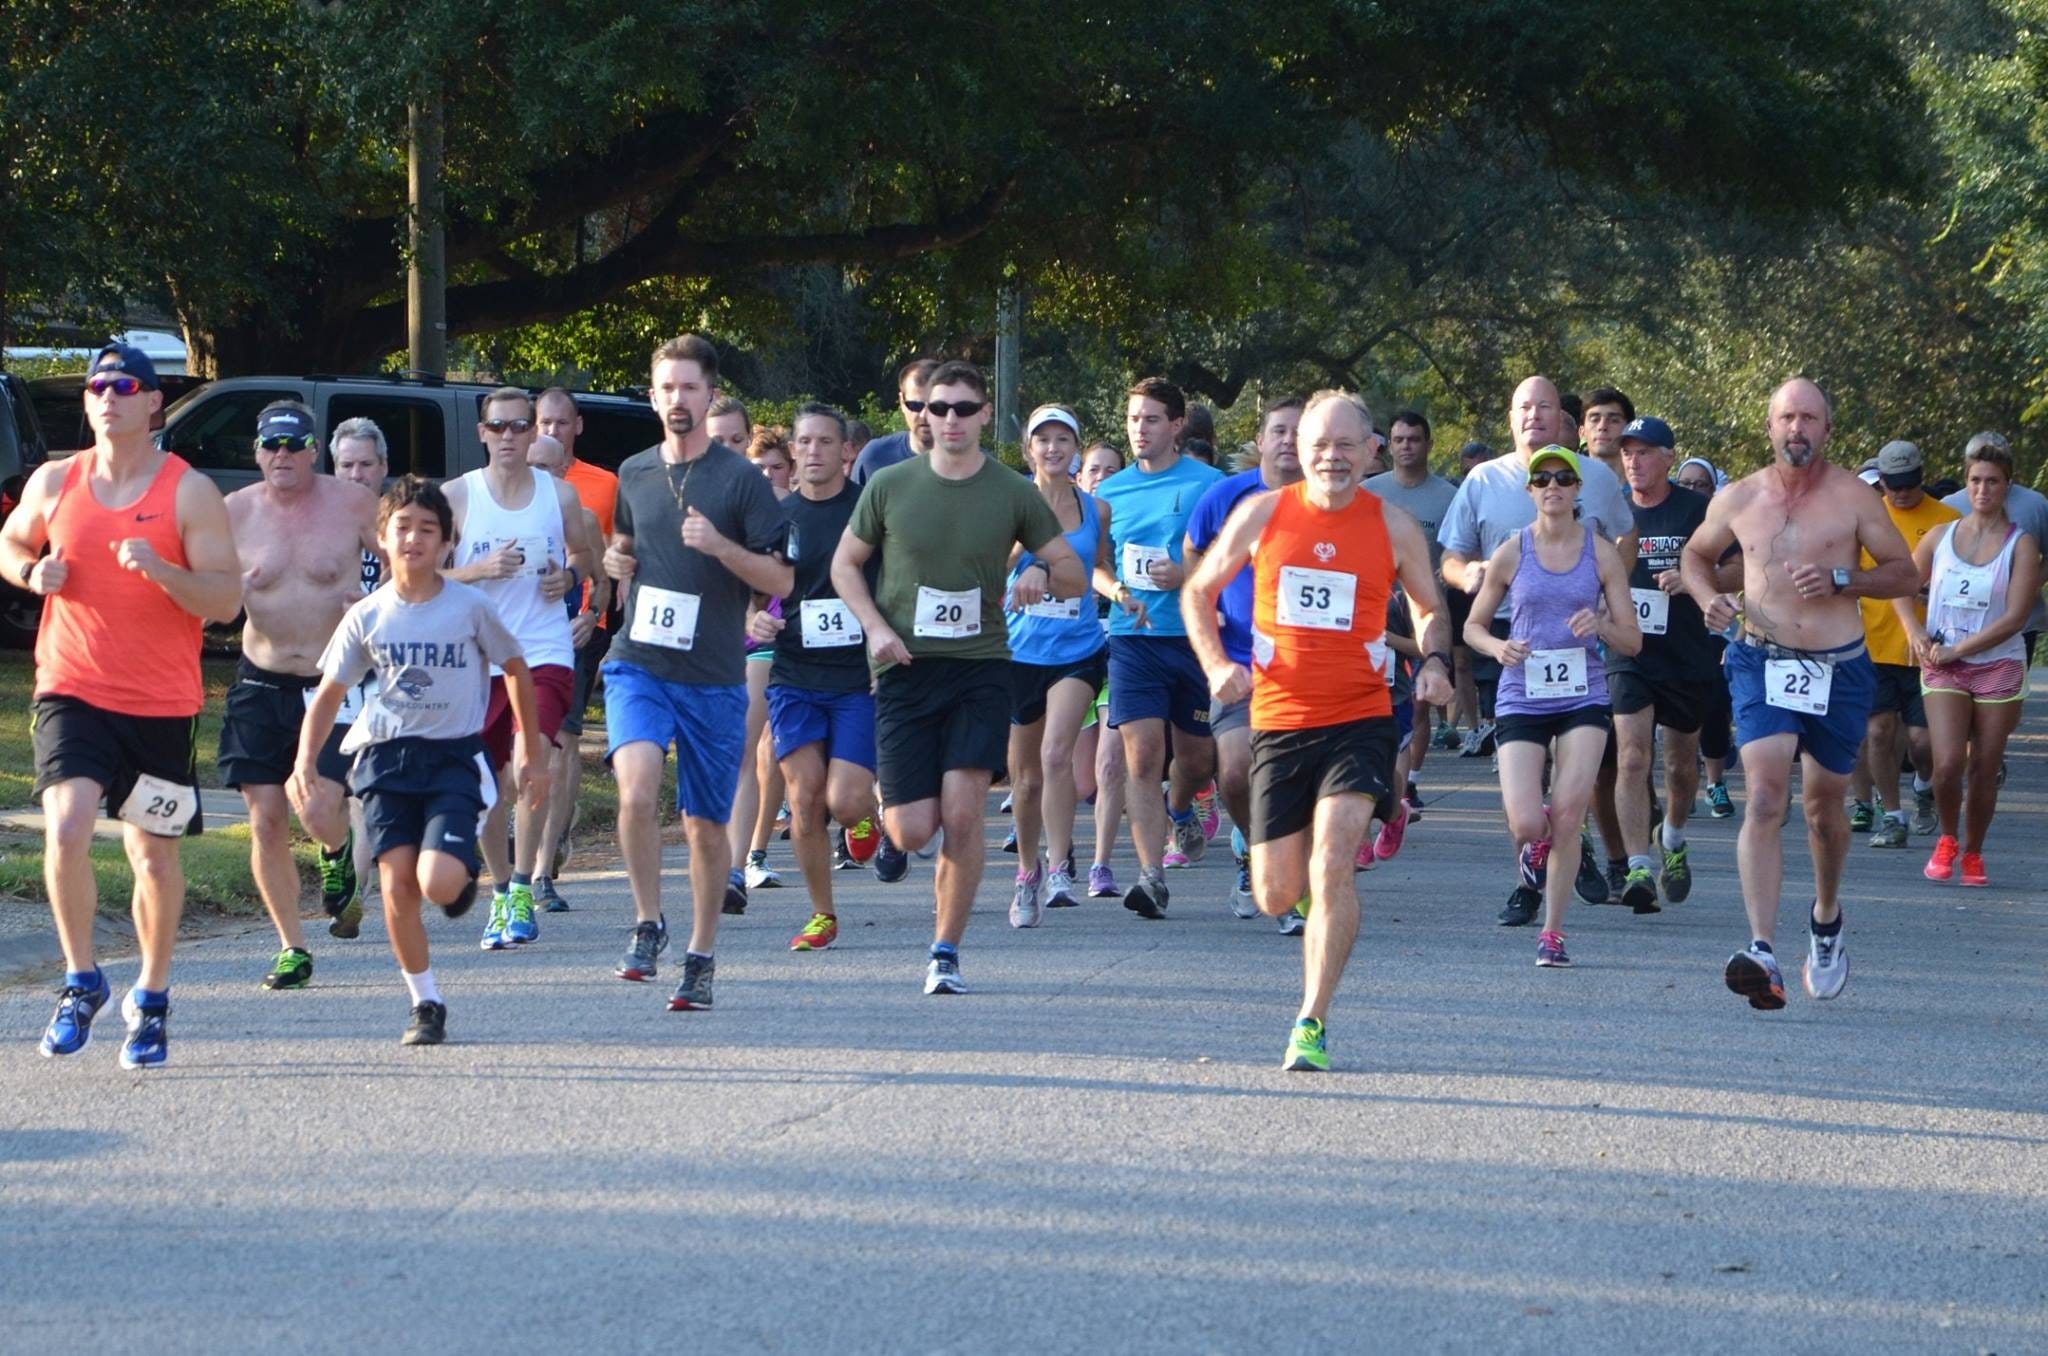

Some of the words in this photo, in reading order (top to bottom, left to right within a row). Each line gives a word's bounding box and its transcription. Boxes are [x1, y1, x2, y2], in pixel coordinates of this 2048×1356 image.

[1300, 585, 1331, 610] 53
[1960, 579, 1970, 595] 2
[649, 605, 676, 628] 18
[818, 612, 844, 632] 34
[935, 604, 962, 622] 20
[1544, 662, 1569, 683] 12
[1784, 673, 1811, 696] 22
[145, 795, 178, 818] 29
